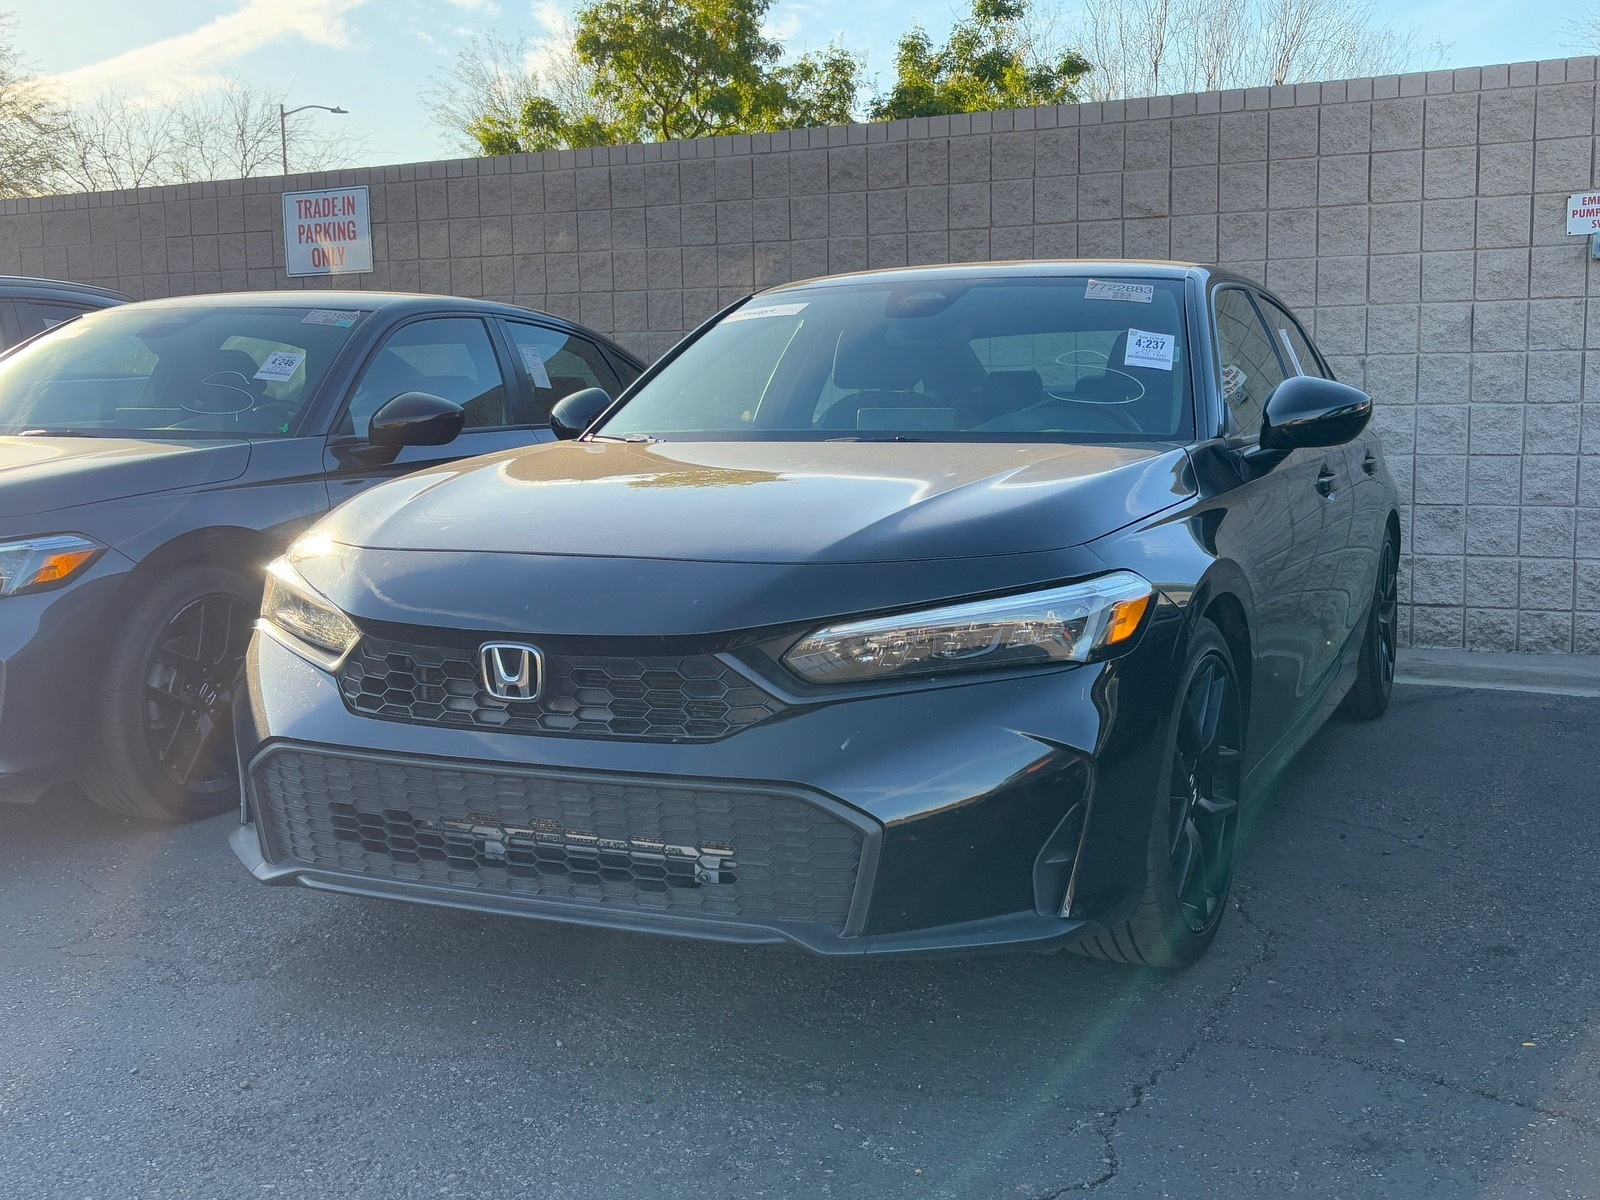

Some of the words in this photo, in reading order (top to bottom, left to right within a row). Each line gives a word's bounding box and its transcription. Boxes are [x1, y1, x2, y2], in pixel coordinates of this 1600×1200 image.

[296, 195, 356, 220] TRADE-IN
[298, 220, 357, 244] PARKING
[311, 246, 345, 268] ONLY
[1089, 283, 1153, 294] 7722883
[1135, 338, 1166, 350] 4:237
[270, 357, 296, 367] 4:246
